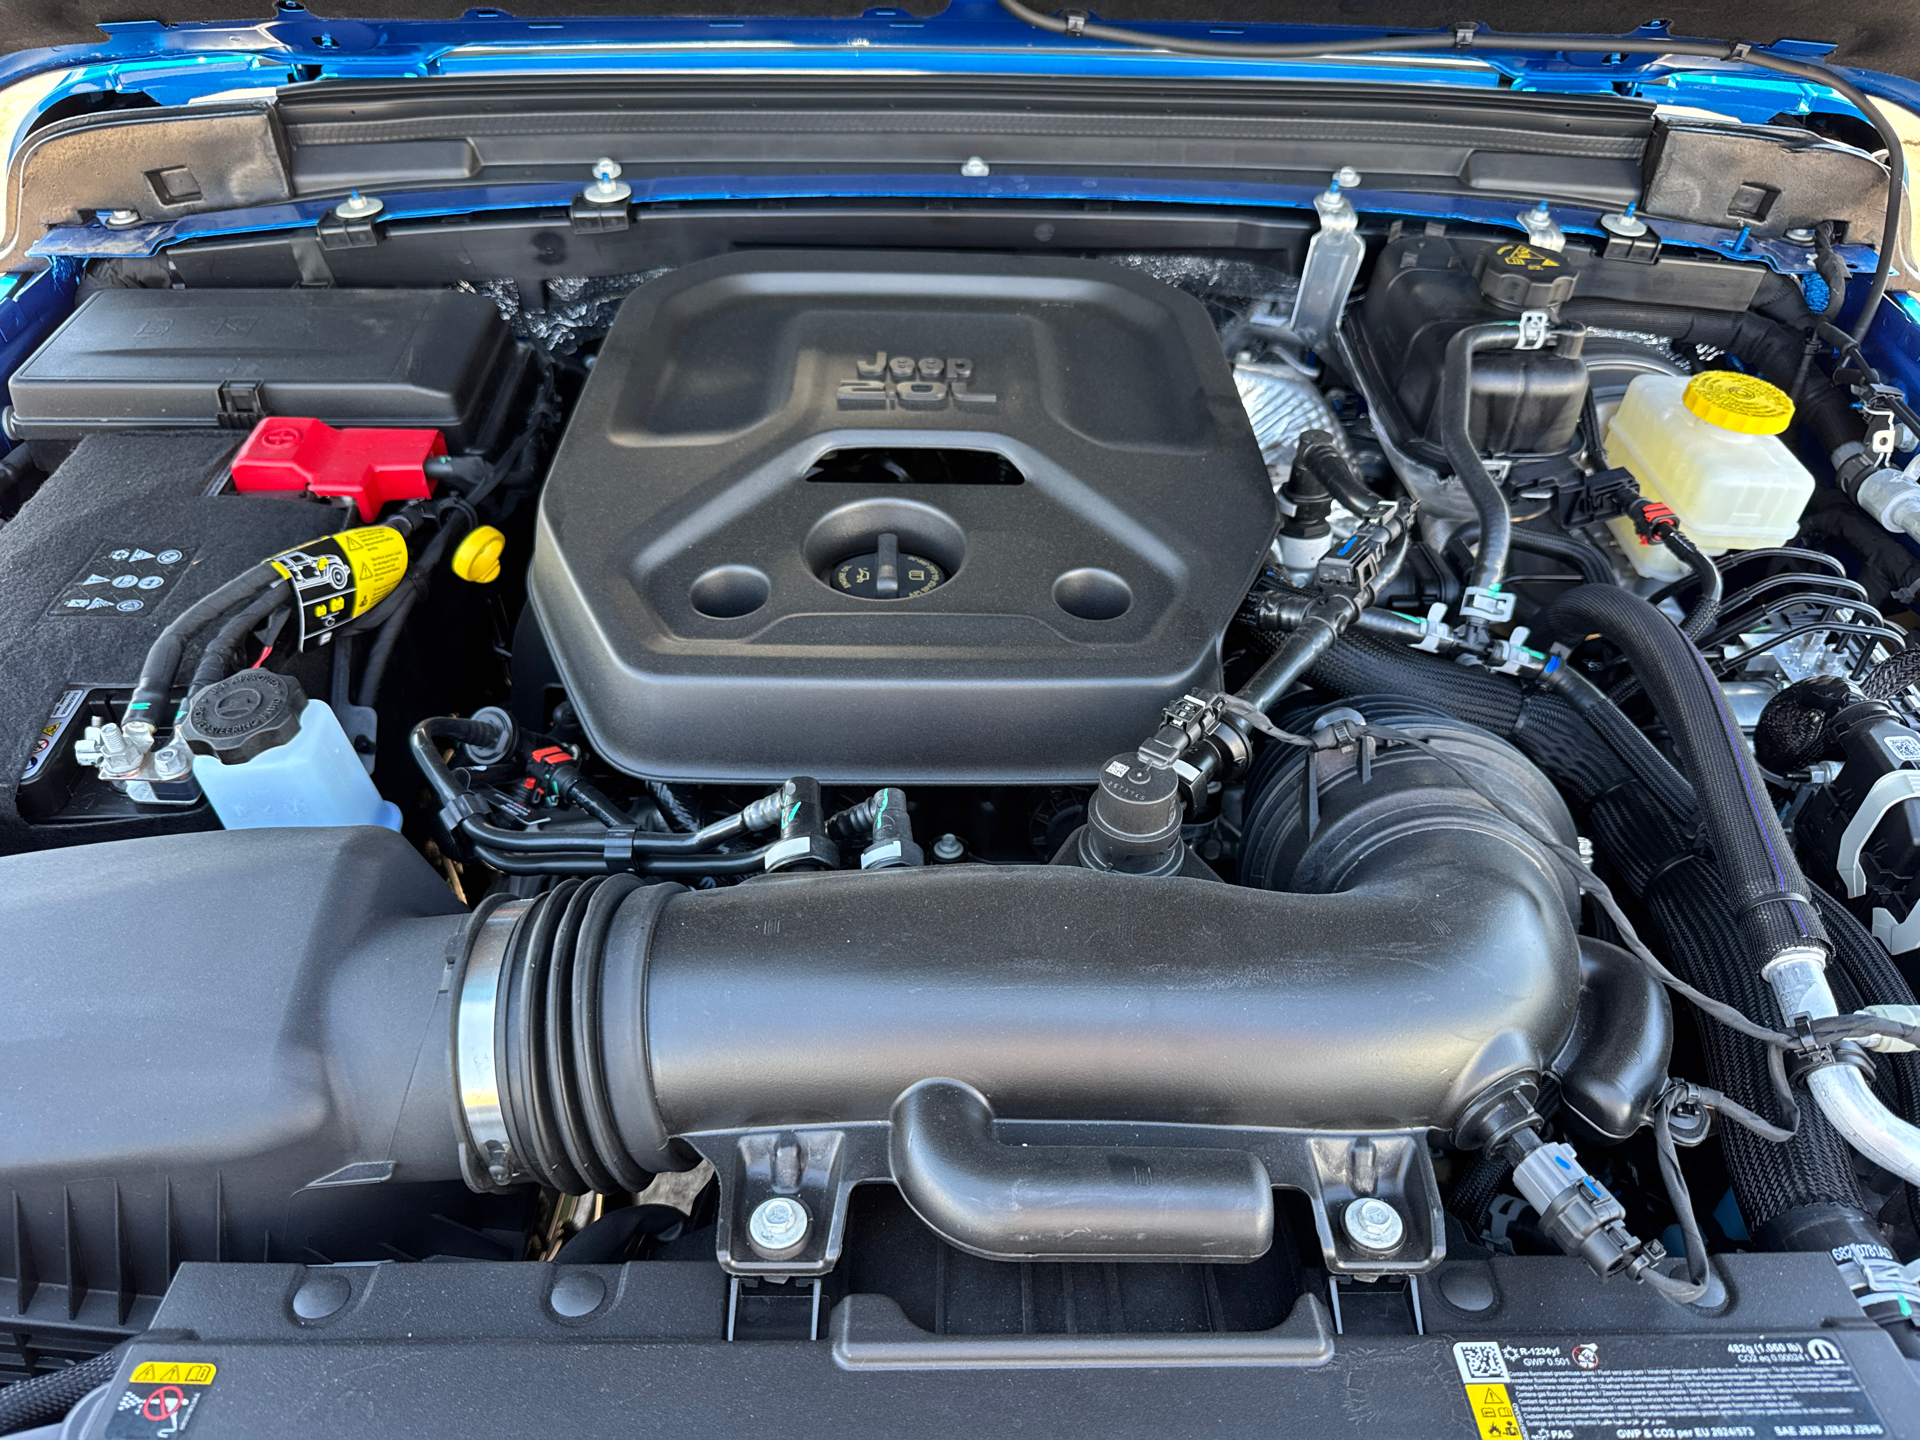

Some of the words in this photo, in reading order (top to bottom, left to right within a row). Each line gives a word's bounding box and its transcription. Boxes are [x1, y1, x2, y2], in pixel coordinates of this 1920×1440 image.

[856, 351, 974, 380] Jeep
[836, 379, 997, 411] 2.0L
[208, 683, 229, 696] USE
[230, 673, 279, 689] APPROVED
[1831, 1243, 1893, 1261] 6820781AD
[1519, 1346, 1560, 1357] R-1234yf
[1727, 1343, 1754, 1355] 482g
[1787, 1342, 1804, 1354] lb)
[1523, 1358, 1546, 1366] GWP
[1547, 1357, 1571, 1366] 0.501
[1737, 1354, 1758, 1363] CO2
[1759, 1355, 1772, 1364] eq
[1551, 1430, 1574, 1440] PAG
[1616, 1428, 1642, 1439] GWP
[1643, 1428, 1653, 1439] &
[1653, 1428, 1676, 1438] CO2
[1676, 1429, 1693, 1440] per
[1693, 1427, 1711, 1438] EU
[1773, 1425, 1798, 1436] SAE
